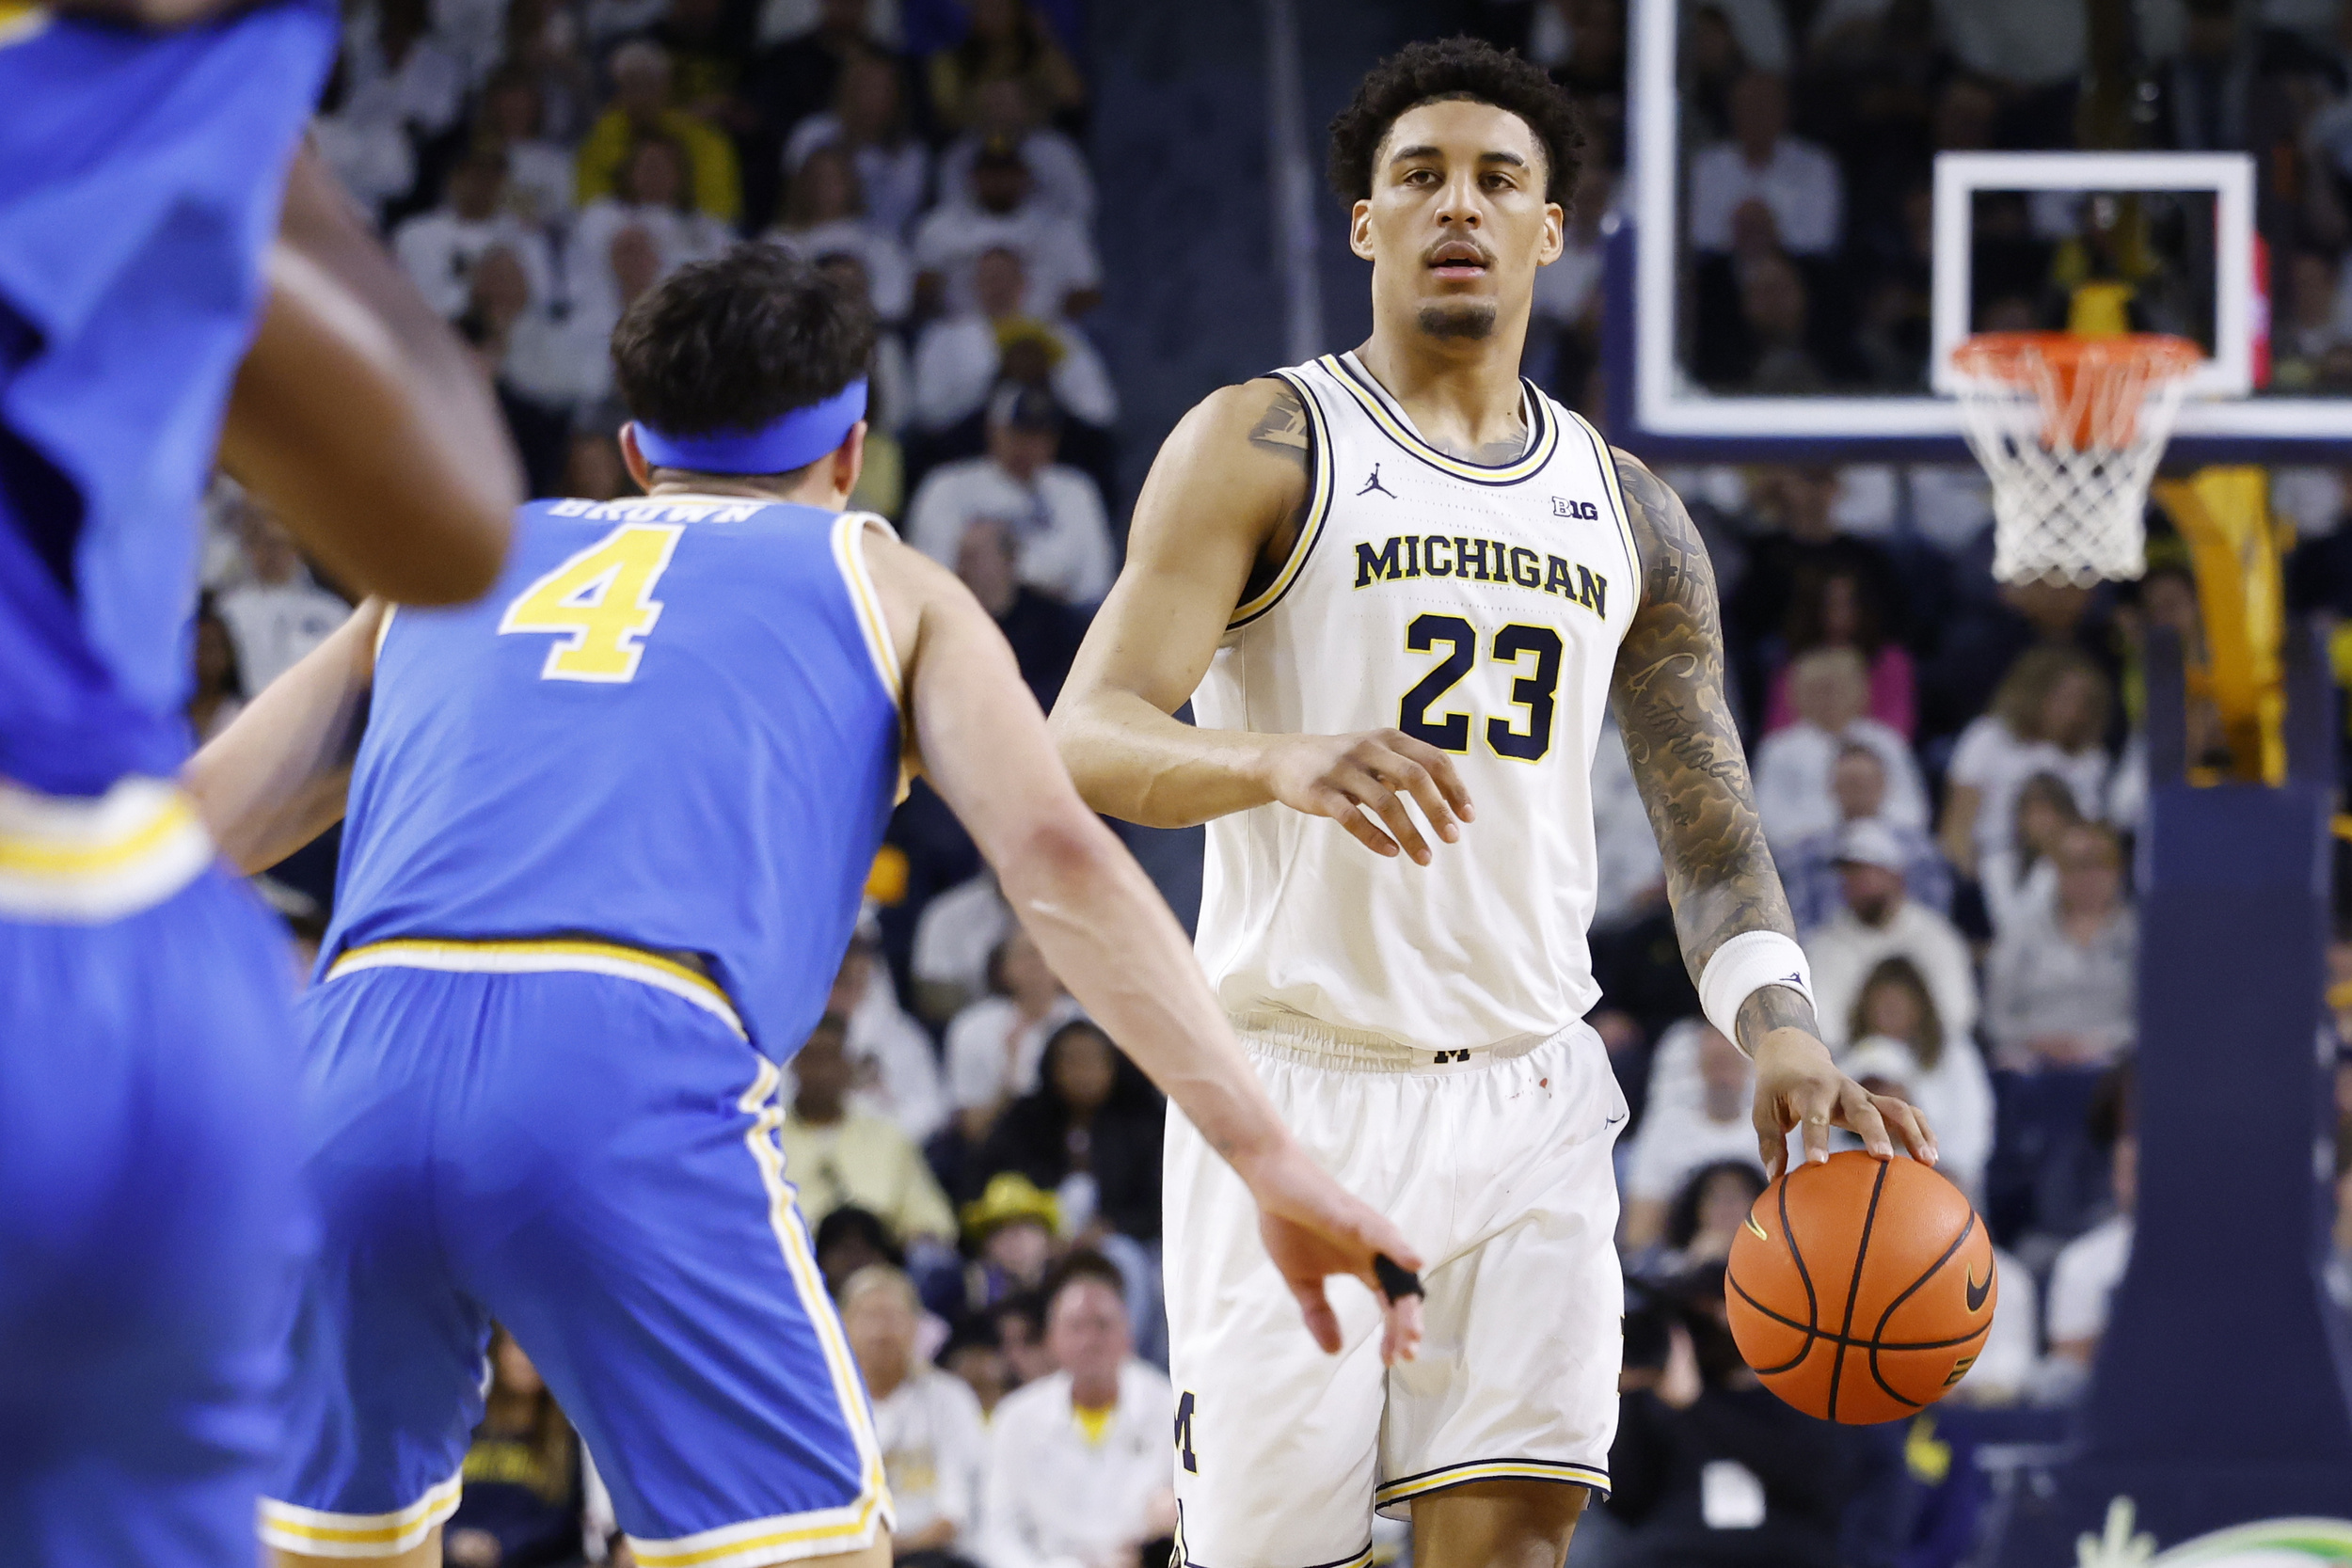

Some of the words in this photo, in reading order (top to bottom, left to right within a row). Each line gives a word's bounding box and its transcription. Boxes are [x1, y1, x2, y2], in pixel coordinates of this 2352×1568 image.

[547, 499, 769, 523] BROWN
[497, 521, 688, 684] 4
[1353, 534, 1608, 623] MICHIGAN
[1398, 613, 1564, 765] 23
